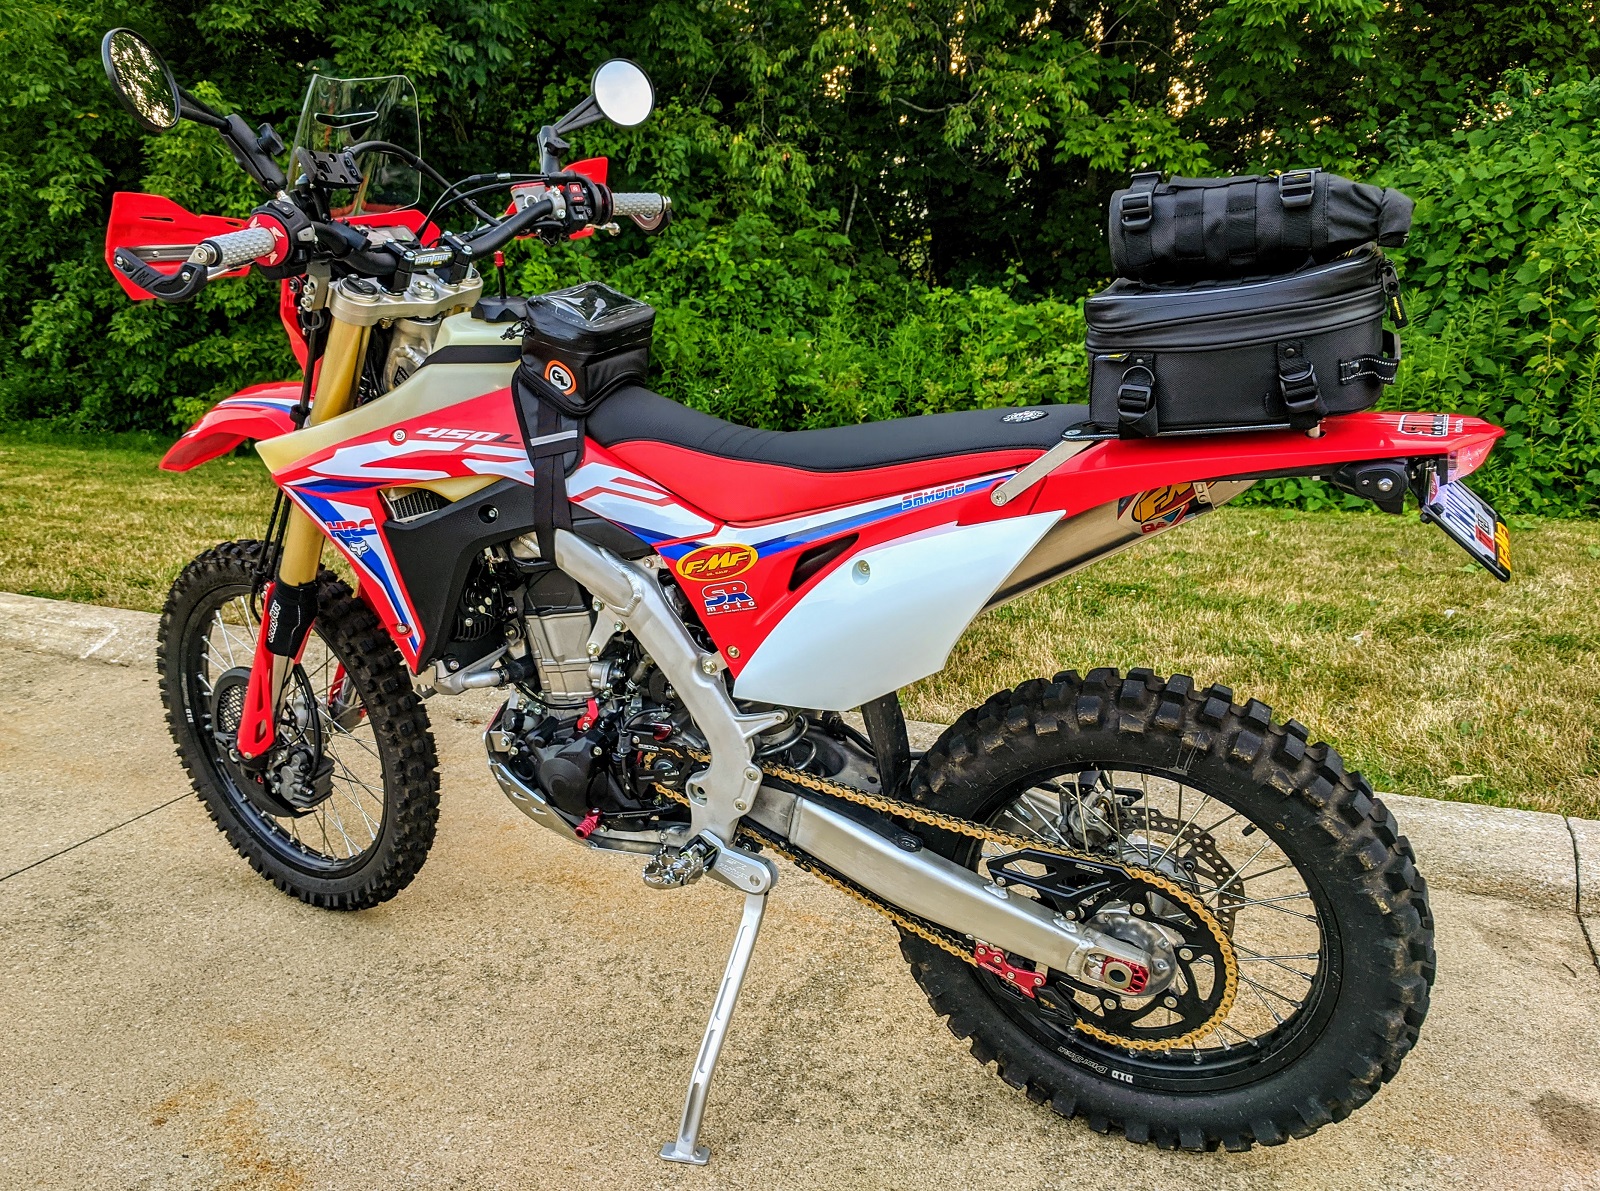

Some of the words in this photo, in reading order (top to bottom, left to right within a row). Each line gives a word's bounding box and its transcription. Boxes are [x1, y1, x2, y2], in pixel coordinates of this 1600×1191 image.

[415, 426, 521, 445] 450L
[901, 482, 965, 510] SRMOTO
[325, 518, 378, 538] HRC
[684, 551, 751, 575] FMF
[701, 580, 753, 607] SR
[706, 600, 755, 613] moto
